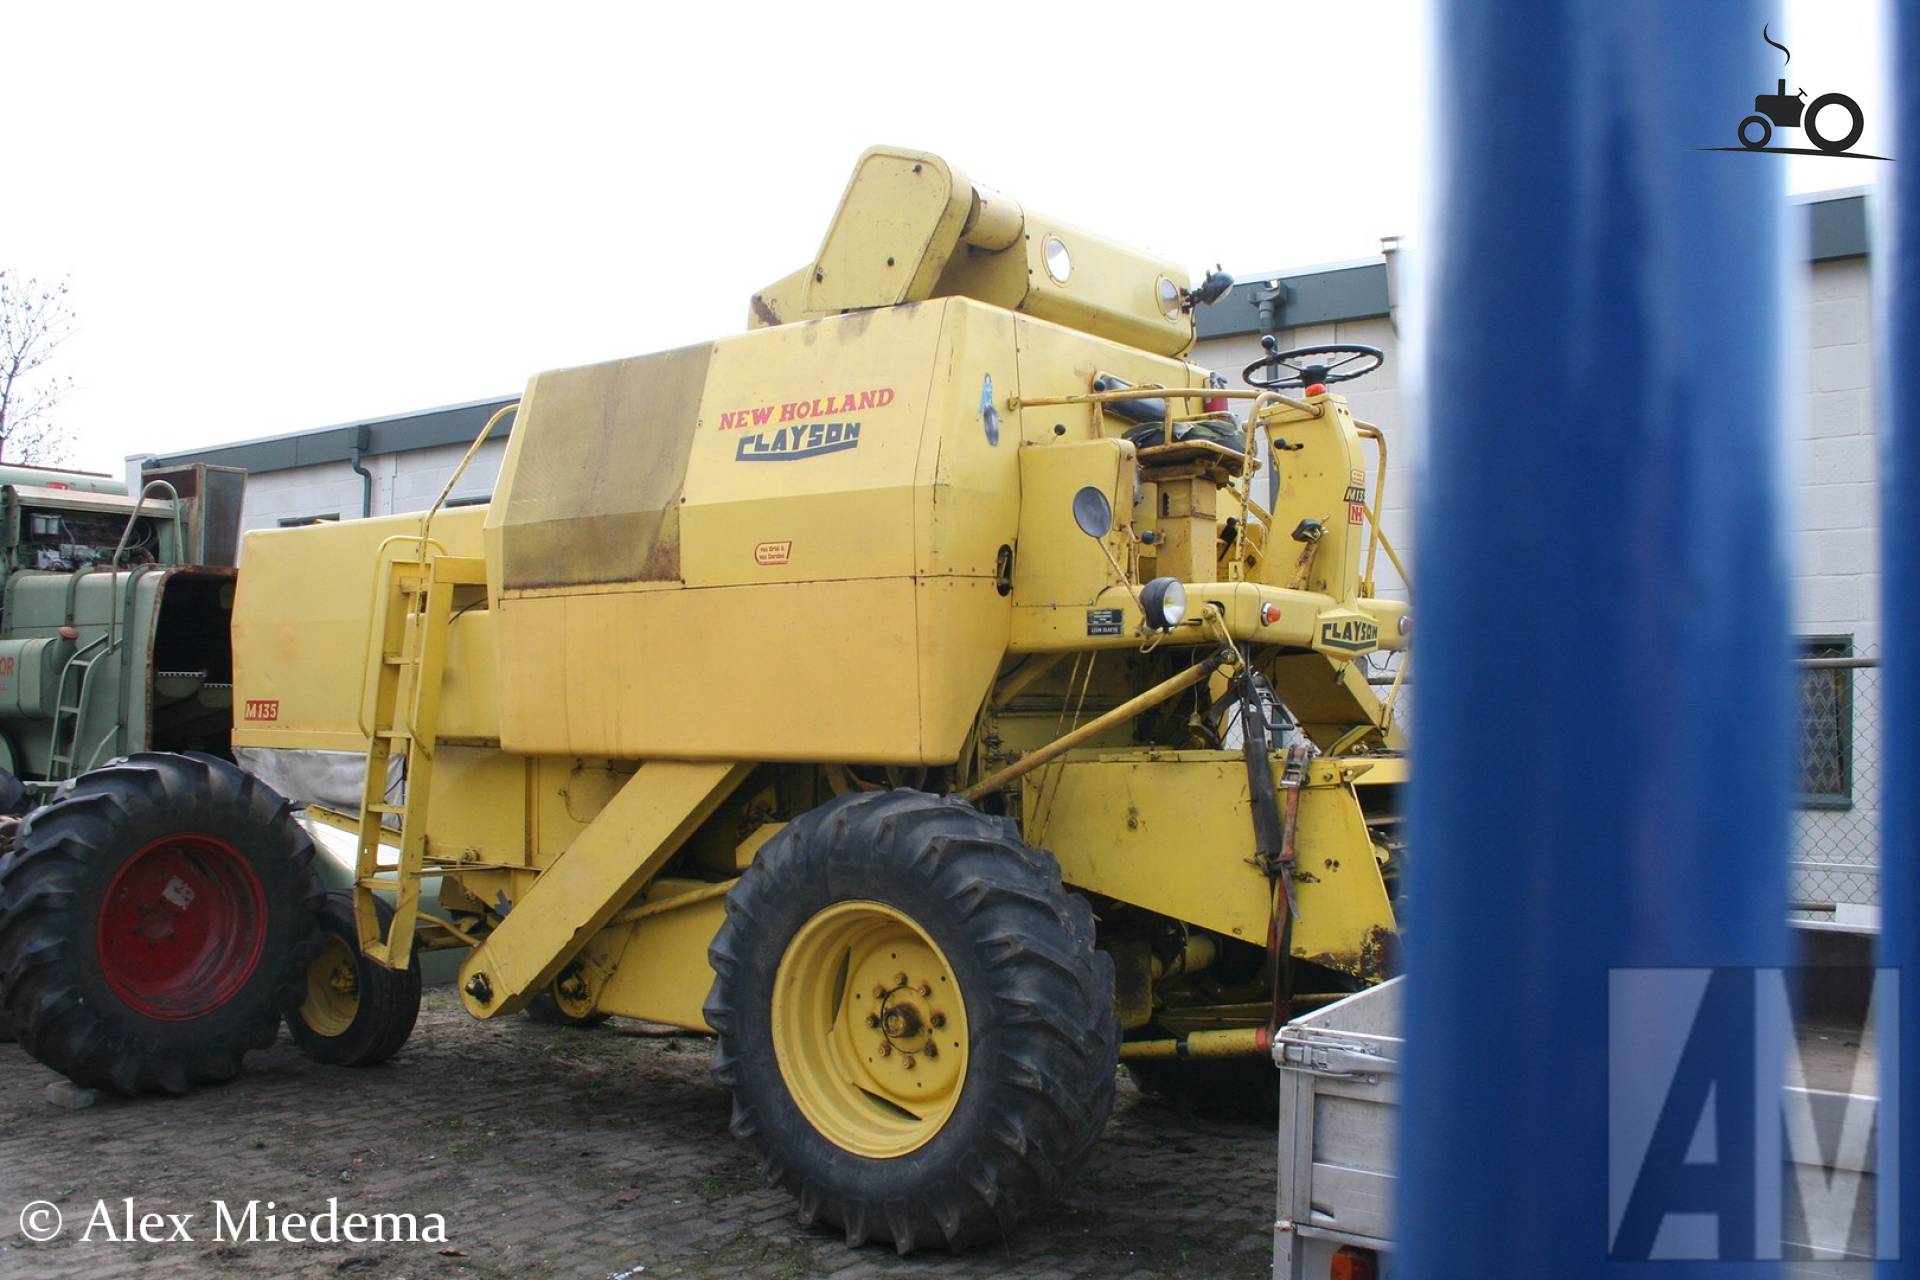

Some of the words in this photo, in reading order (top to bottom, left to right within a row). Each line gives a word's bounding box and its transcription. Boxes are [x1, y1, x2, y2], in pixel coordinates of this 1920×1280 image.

[718, 406, 775, 431] NEW
[779, 387, 895, 423] HOLLAND
[735, 422, 861, 462] CLAYSON
[1346, 488, 1365, 502] M13
[1321, 620, 1378, 651] CLAYSON
[246, 702, 278, 719] M135
